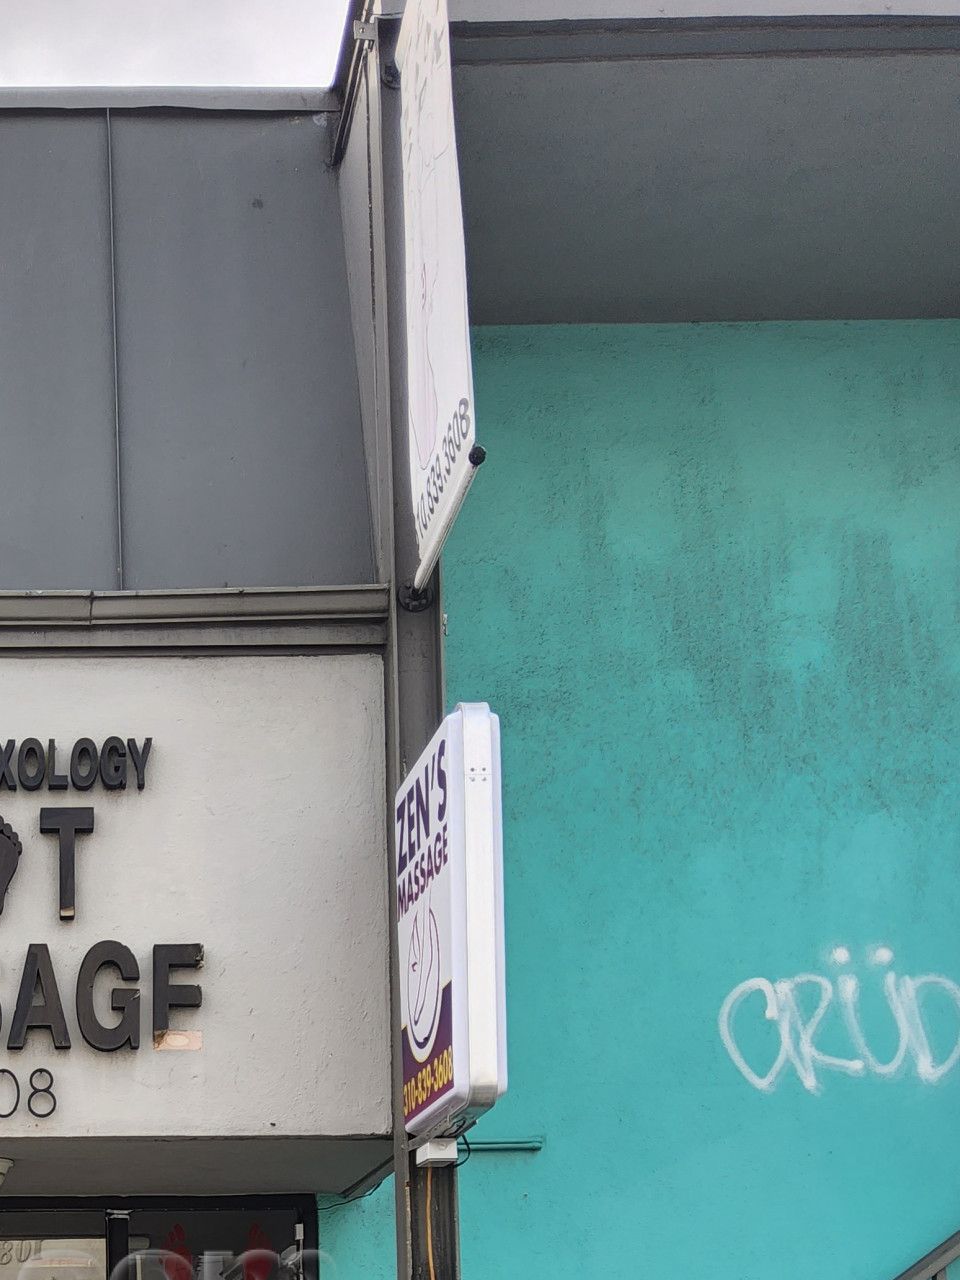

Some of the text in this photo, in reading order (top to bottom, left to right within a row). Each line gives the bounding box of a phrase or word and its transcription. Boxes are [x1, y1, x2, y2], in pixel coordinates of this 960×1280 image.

[396, 739, 447, 878] ZEN'S
[397, 823, 448, 923] MASSAGE
[403, 1045, 453, 1116] 310-839-3608
